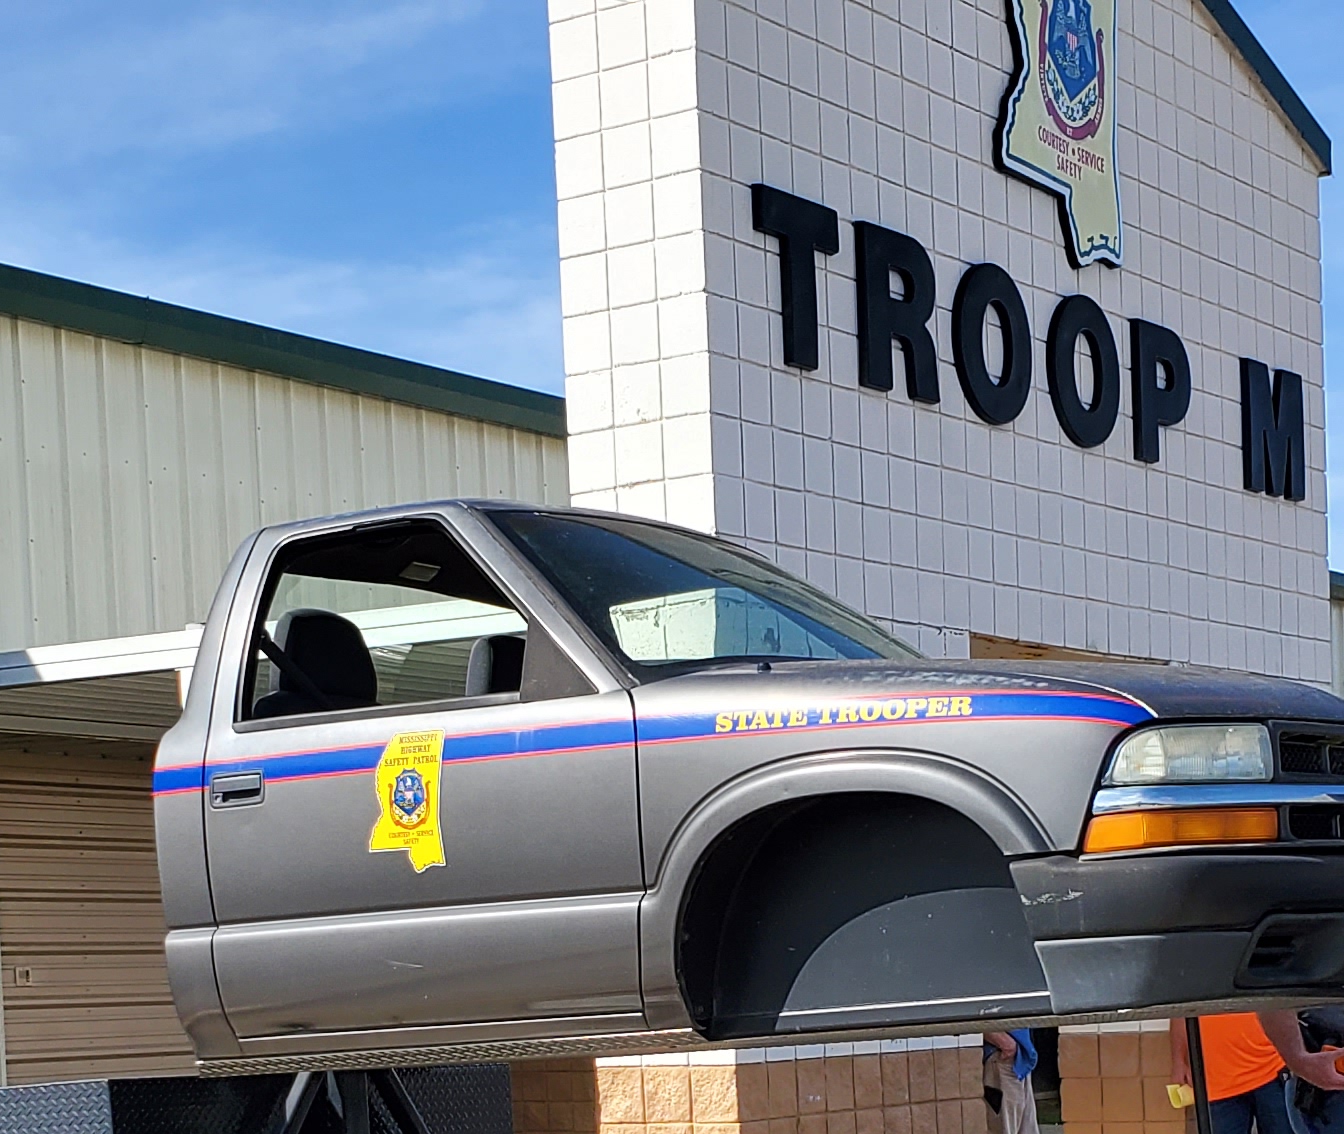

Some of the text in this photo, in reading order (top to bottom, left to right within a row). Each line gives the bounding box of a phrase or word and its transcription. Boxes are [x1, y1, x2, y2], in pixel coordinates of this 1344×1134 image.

[1038, 125, 1105, 174] COURTESY SERVICE
[1057, 154, 1083, 181] SAFETY
[751, 183, 1306, 502] TROOP M
[715, 696, 973, 733] STATE TROOPER
[398, 733, 438, 745] MISSISSIPPI
[400, 744, 431, 755] HIGHWAY
[384, 754, 439, 767] SAFETY PATROL
